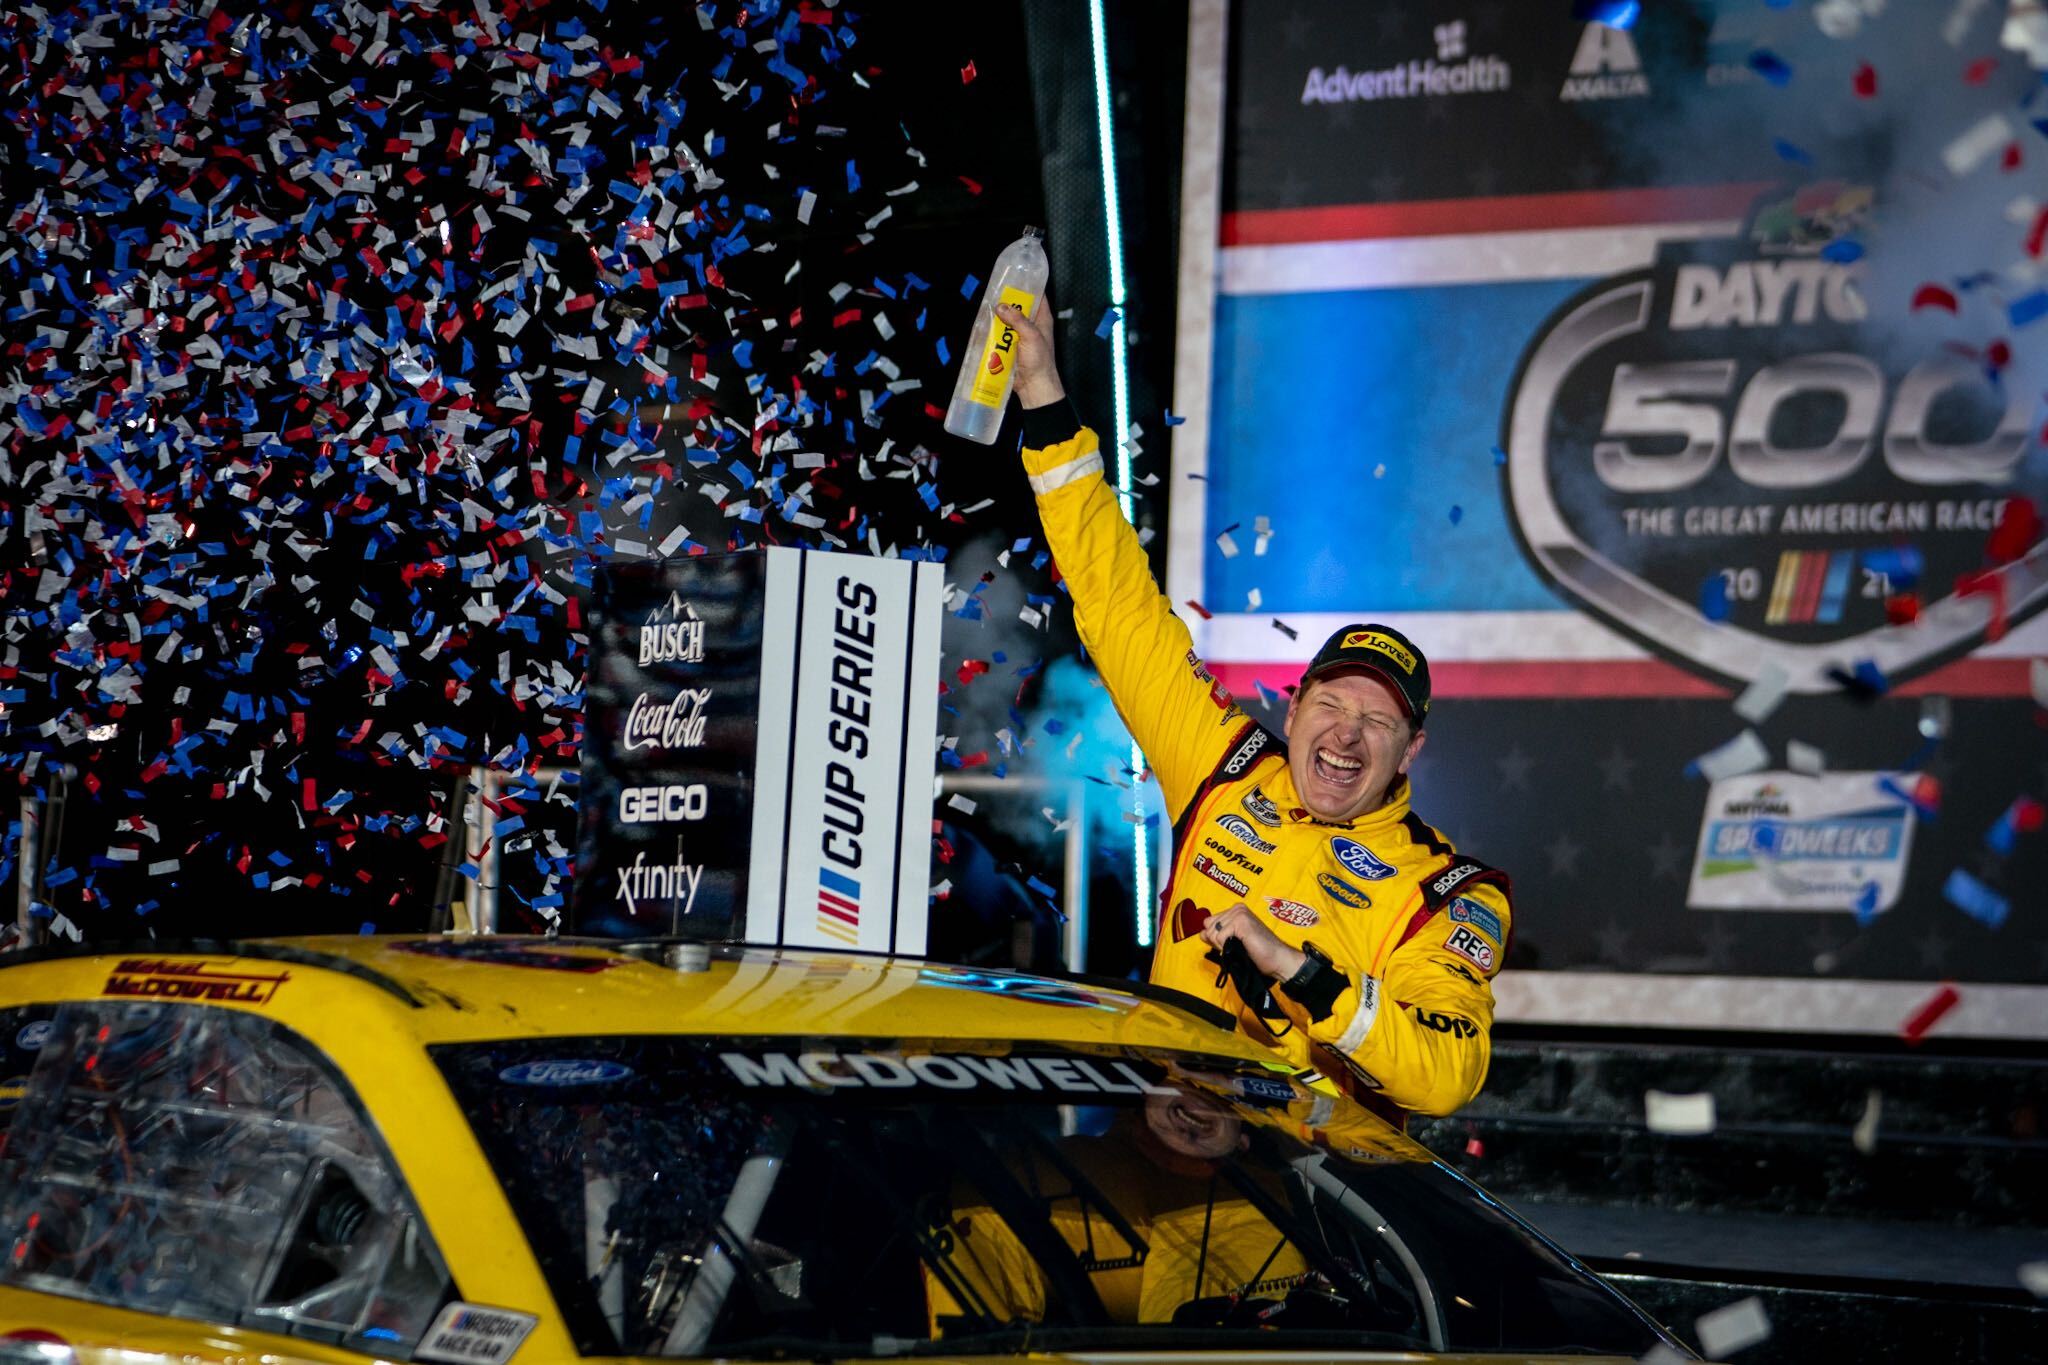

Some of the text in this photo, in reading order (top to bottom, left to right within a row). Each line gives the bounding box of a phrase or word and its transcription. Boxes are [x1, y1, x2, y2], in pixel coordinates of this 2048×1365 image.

[1301, 55, 1510, 104] AdventHealth
[1559, 74, 1649, 101] AXALTA
[1670, 259, 1868, 330] DAYTO
[1592, 353, 2034, 493] 500
[1623, 506, 1675, 536] THE
[1684, 503, 1772, 535] GREAT
[1780, 500, 1931, 534] AMERICAN
[638, 620, 705, 667] BUSCH
[1368, 635, 1413, 669] Love's
[624, 687, 714, 750] Coca-Cola
[822, 575, 878, 870] CUP SERIES
[1224, 728, 1268, 774] sparco
[620, 784, 708, 823] GEICO
[1204, 837, 1264, 876] GOODYEAR
[1714, 823, 1891, 858] SPDWEEKS
[1340, 845, 1387, 878] Ford
[615, 851, 704, 915] xfinity
[1319, 873, 1370, 909] speedco
[1278, 910, 1313, 927] CASH
[1280, 899, 1319, 921] SPEEDY
[526, 1061, 604, 1083] Ford
[718, 1052, 1183, 1096] MCDOWELL
[469, 1339, 504, 1358] CAR
